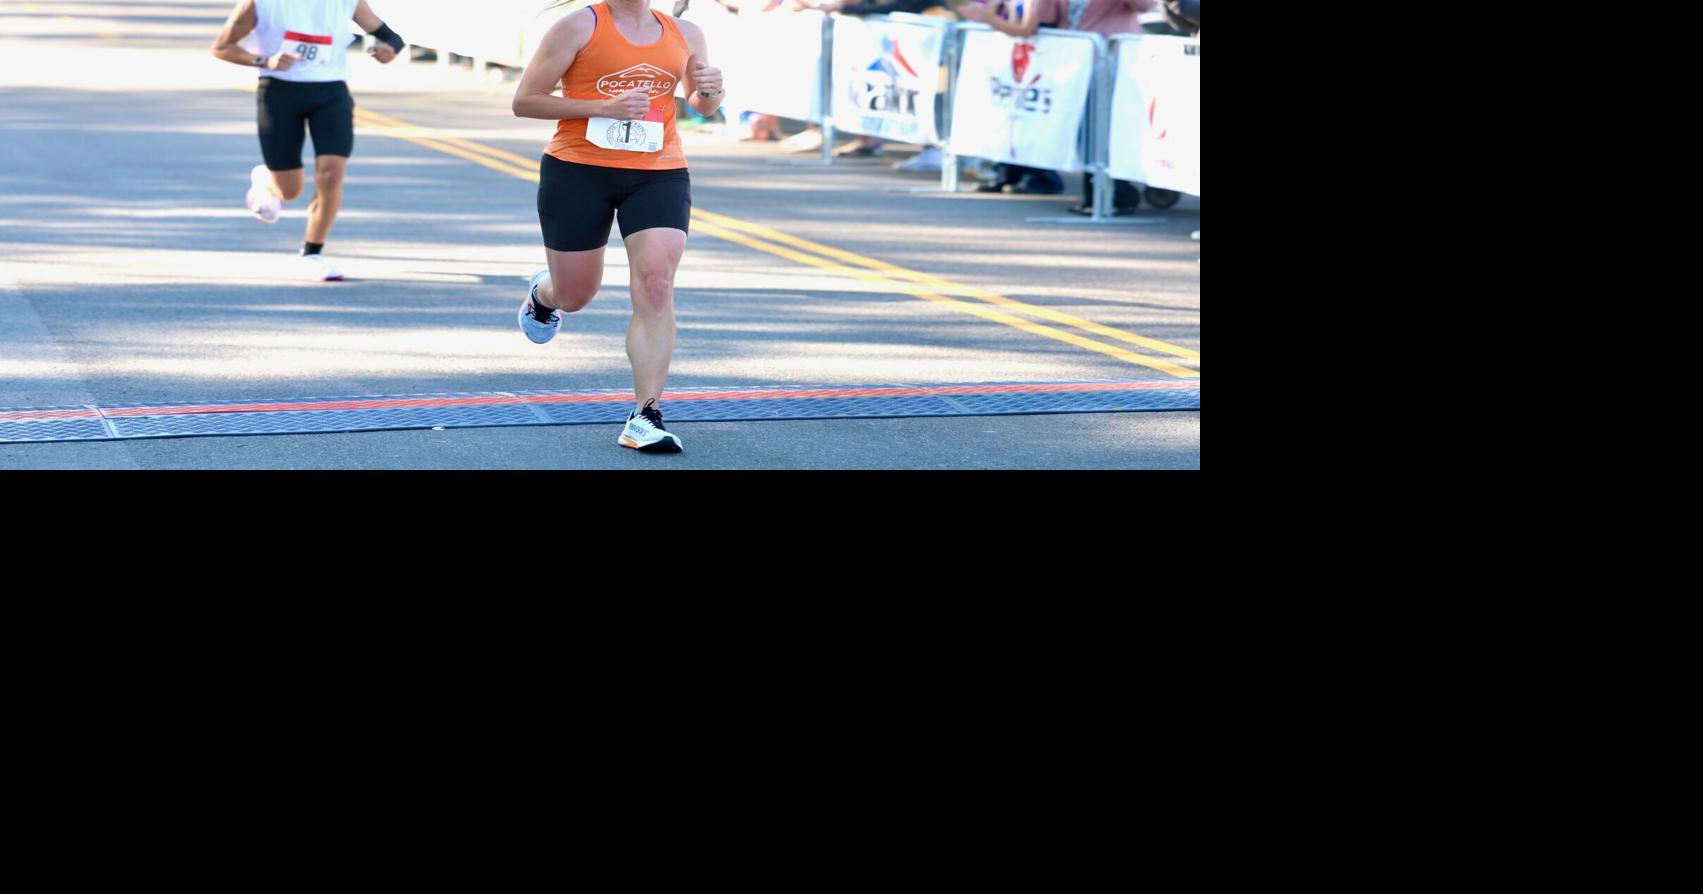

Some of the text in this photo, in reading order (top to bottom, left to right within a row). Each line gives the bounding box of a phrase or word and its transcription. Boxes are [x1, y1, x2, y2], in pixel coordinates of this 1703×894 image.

[296, 44, 318, 61] 98
[600, 80, 671, 89] POCATELLO
[622, 121, 632, 143] 1
